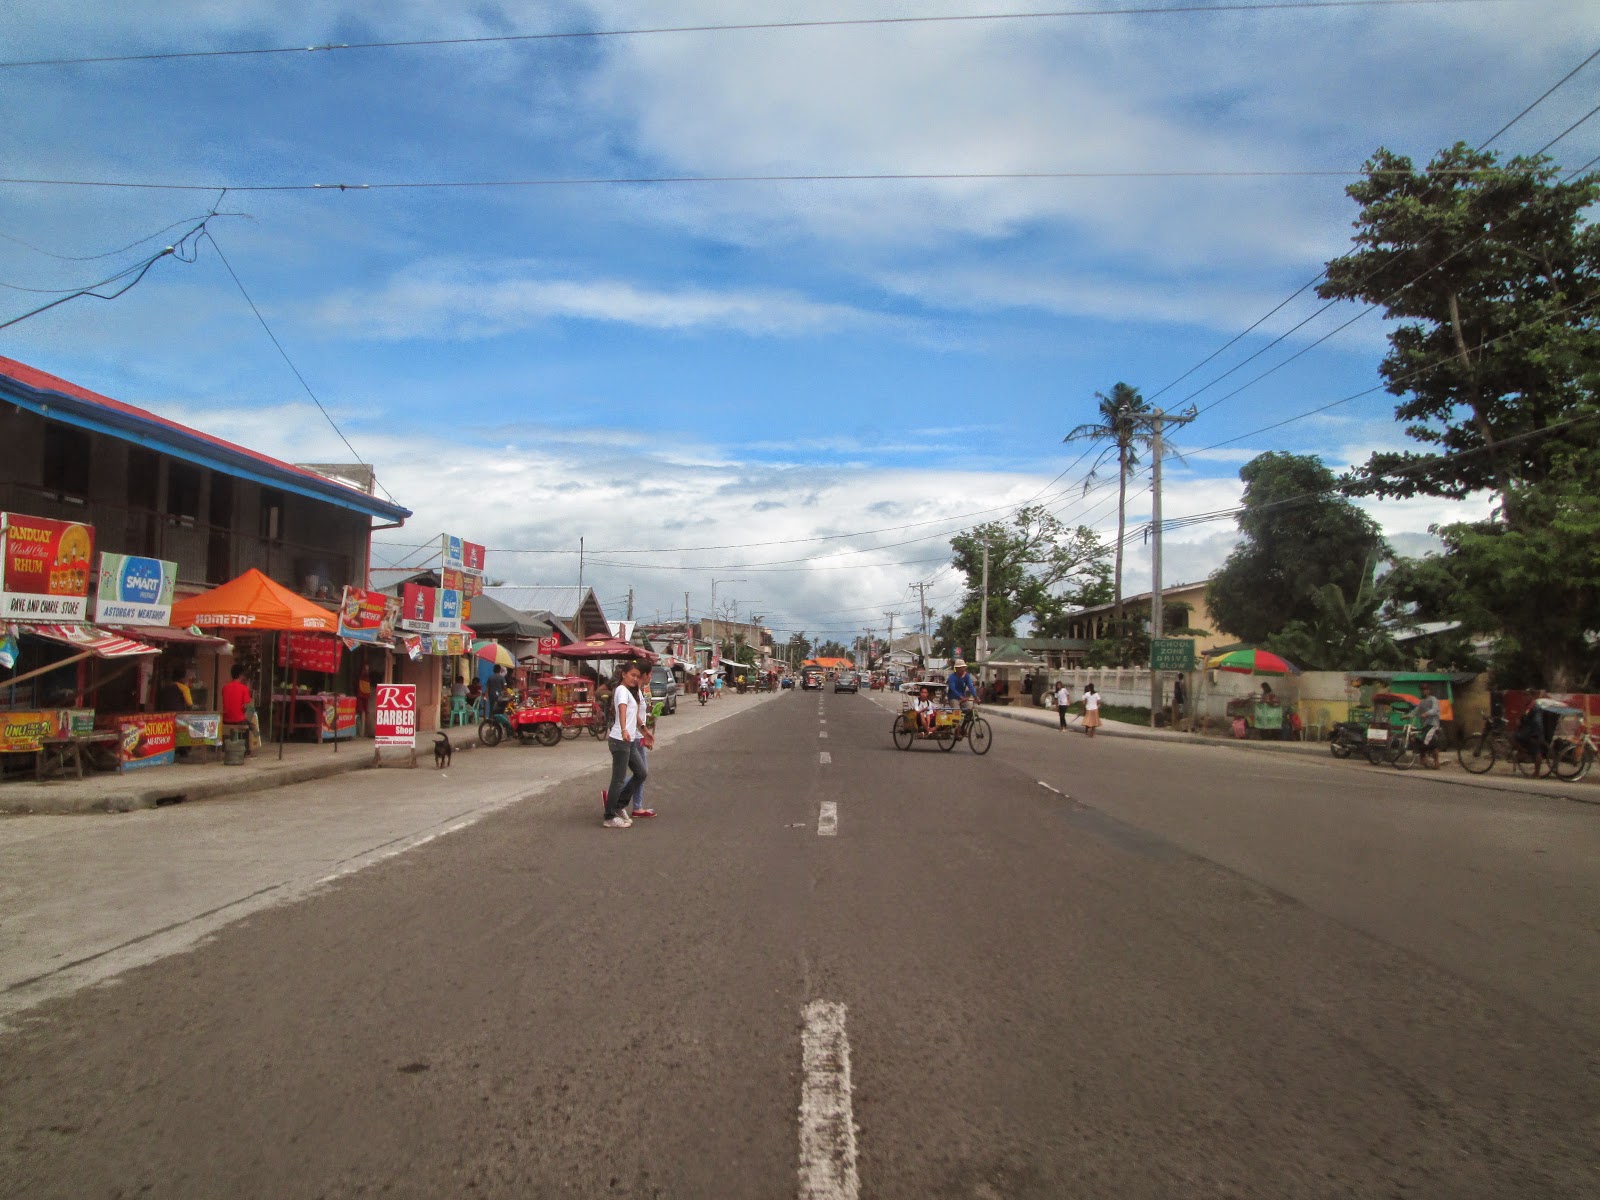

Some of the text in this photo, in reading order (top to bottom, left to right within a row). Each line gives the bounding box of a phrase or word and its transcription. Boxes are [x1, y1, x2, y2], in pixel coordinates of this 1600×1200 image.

[9, 525, 52, 543] TANDUAY
[14, 557, 43, 573] RHUM
[126, 575, 159, 591] SMART
[10, 597, 26, 612] DAVE
[26, 599, 40, 613] AND
[61, 601, 80, 615] STORE
[103, 606, 166, 620] ASTORGA'S MEATSHOP
[195, 613, 256, 625] HOMETOP
[376, 687, 415, 709] Rs
[376, 709, 415, 726] BARBER
[4, 724, 27, 737] UNLI
[143, 721, 173, 736] ASTORGA'S
[395, 725, 413, 735] Shop
[147, 736, 171, 746] MEATSHOP
